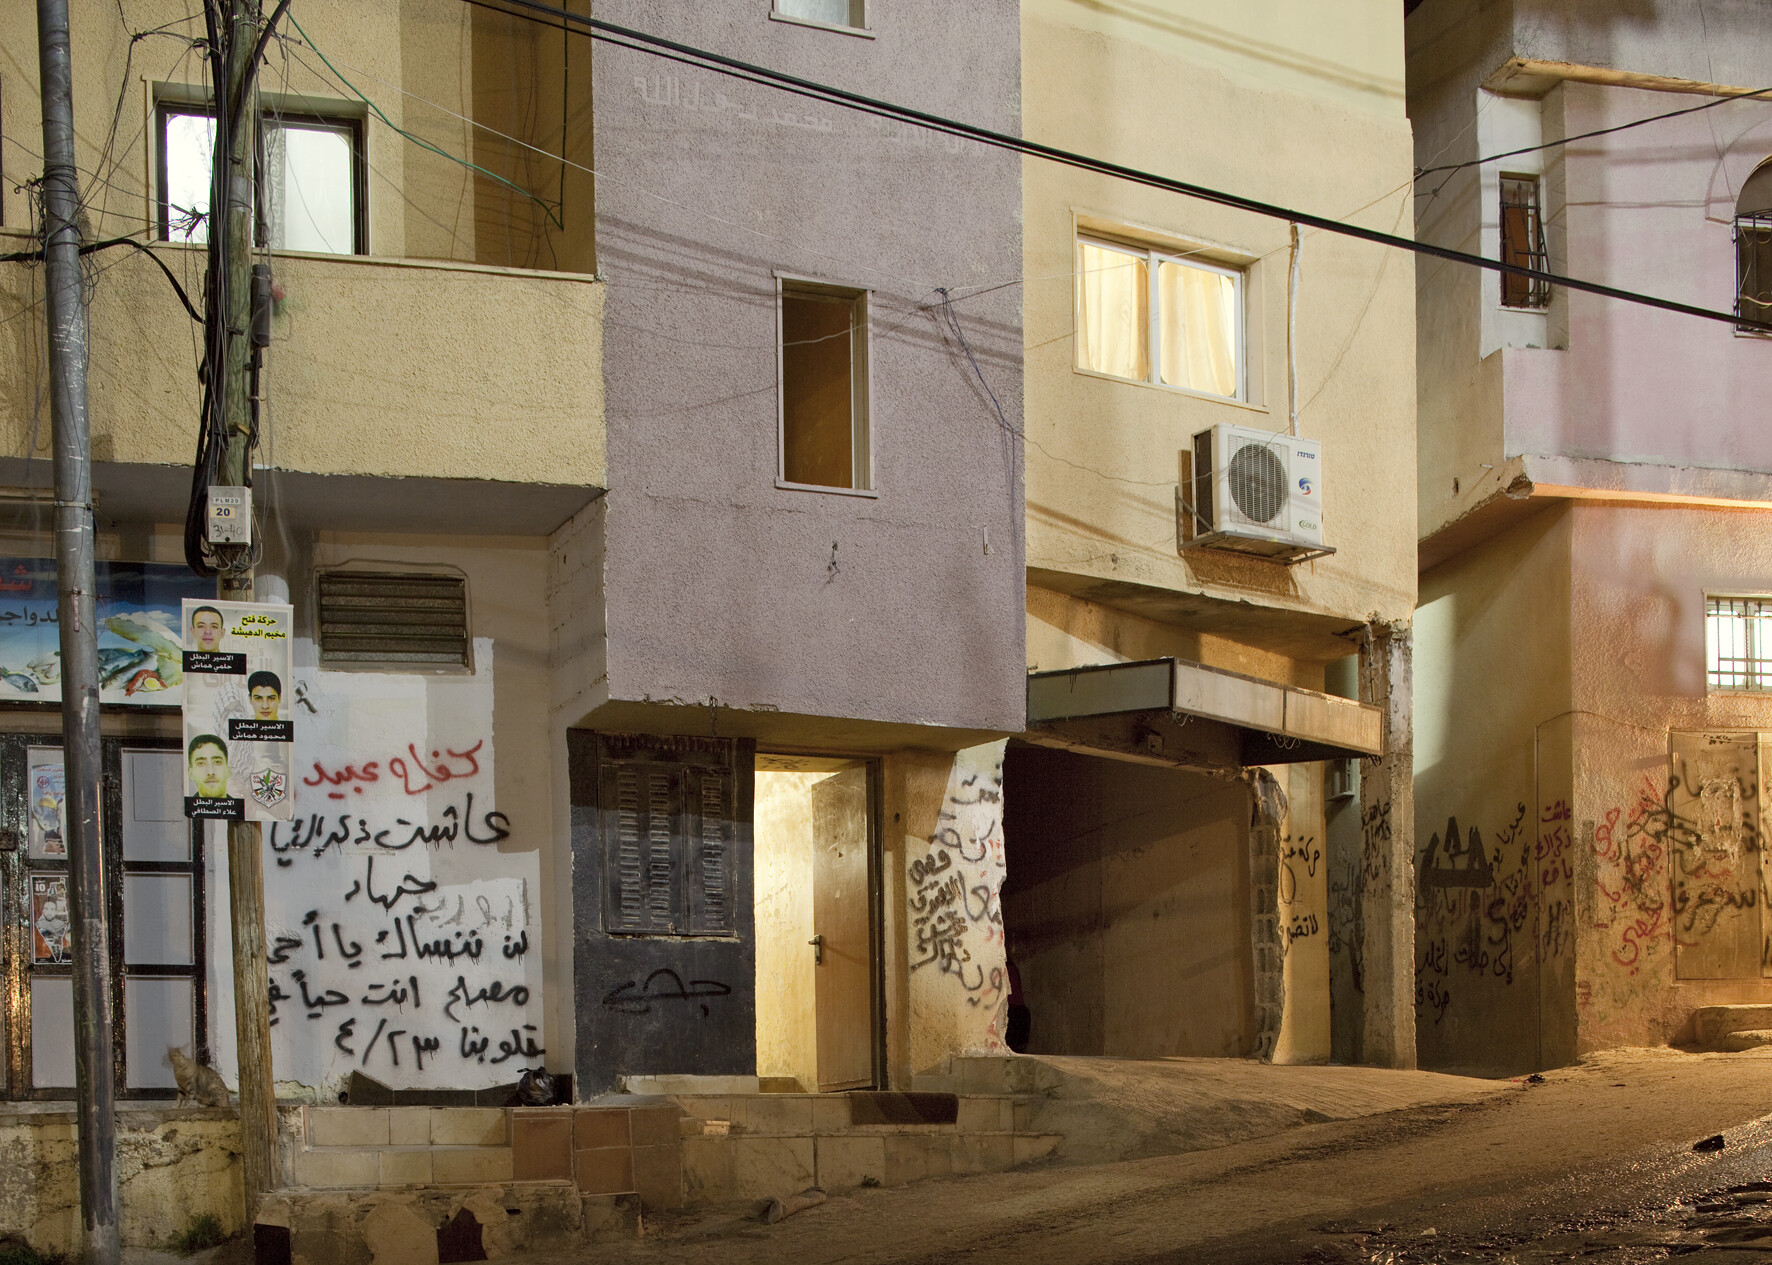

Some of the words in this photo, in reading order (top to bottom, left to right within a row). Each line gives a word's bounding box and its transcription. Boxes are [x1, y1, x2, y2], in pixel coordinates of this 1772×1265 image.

[216, 507, 231, 517] 20
[241, 614, 256, 626] فتح
[257, 615, 277, 626] حركة
[230, 625, 263, 639] الدهيشة
[264, 628, 287, 640] مخيم
[189, 653, 210, 661] البطل
[234, 722, 259, 730] البطل
[302, 760, 380, 800] عبيد
[192, 798, 213, 806] البطل
[1541, 799, 1572, 823] عاشت
[373, 792, 512, 852] عاشت
[330, 921, 363, 969] يا
[502, 929, 532, 960] لن
